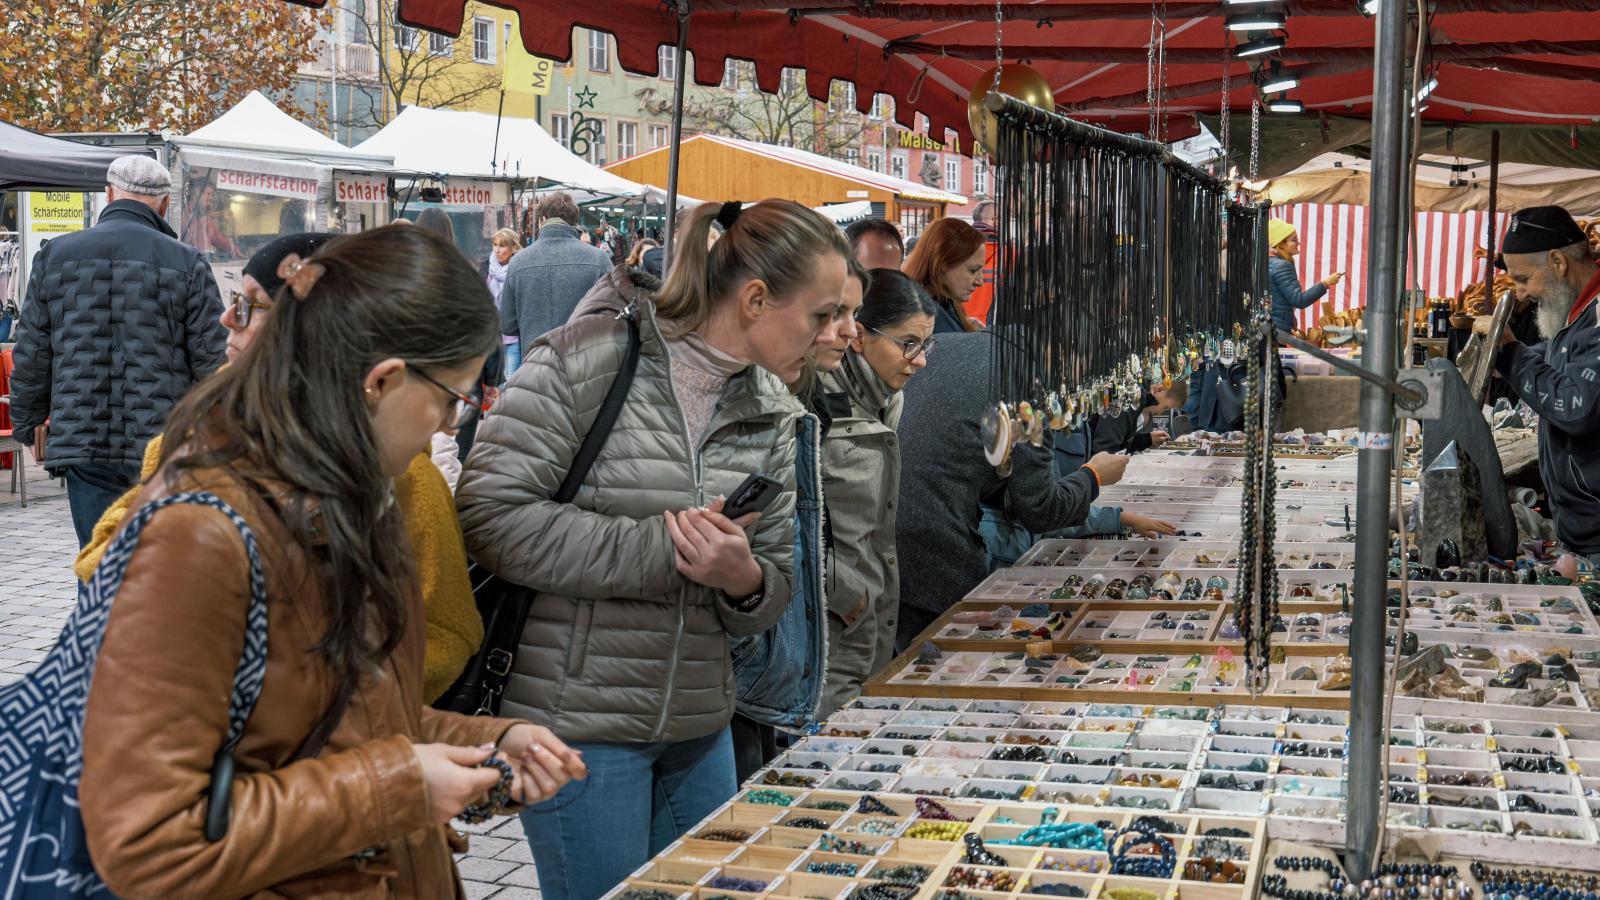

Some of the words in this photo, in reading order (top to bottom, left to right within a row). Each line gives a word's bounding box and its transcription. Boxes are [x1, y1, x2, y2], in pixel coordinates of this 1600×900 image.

[338, 180, 387, 201] Schärf
[446, 184, 491, 204] station
[33, 207, 83, 218] Schärfstation
